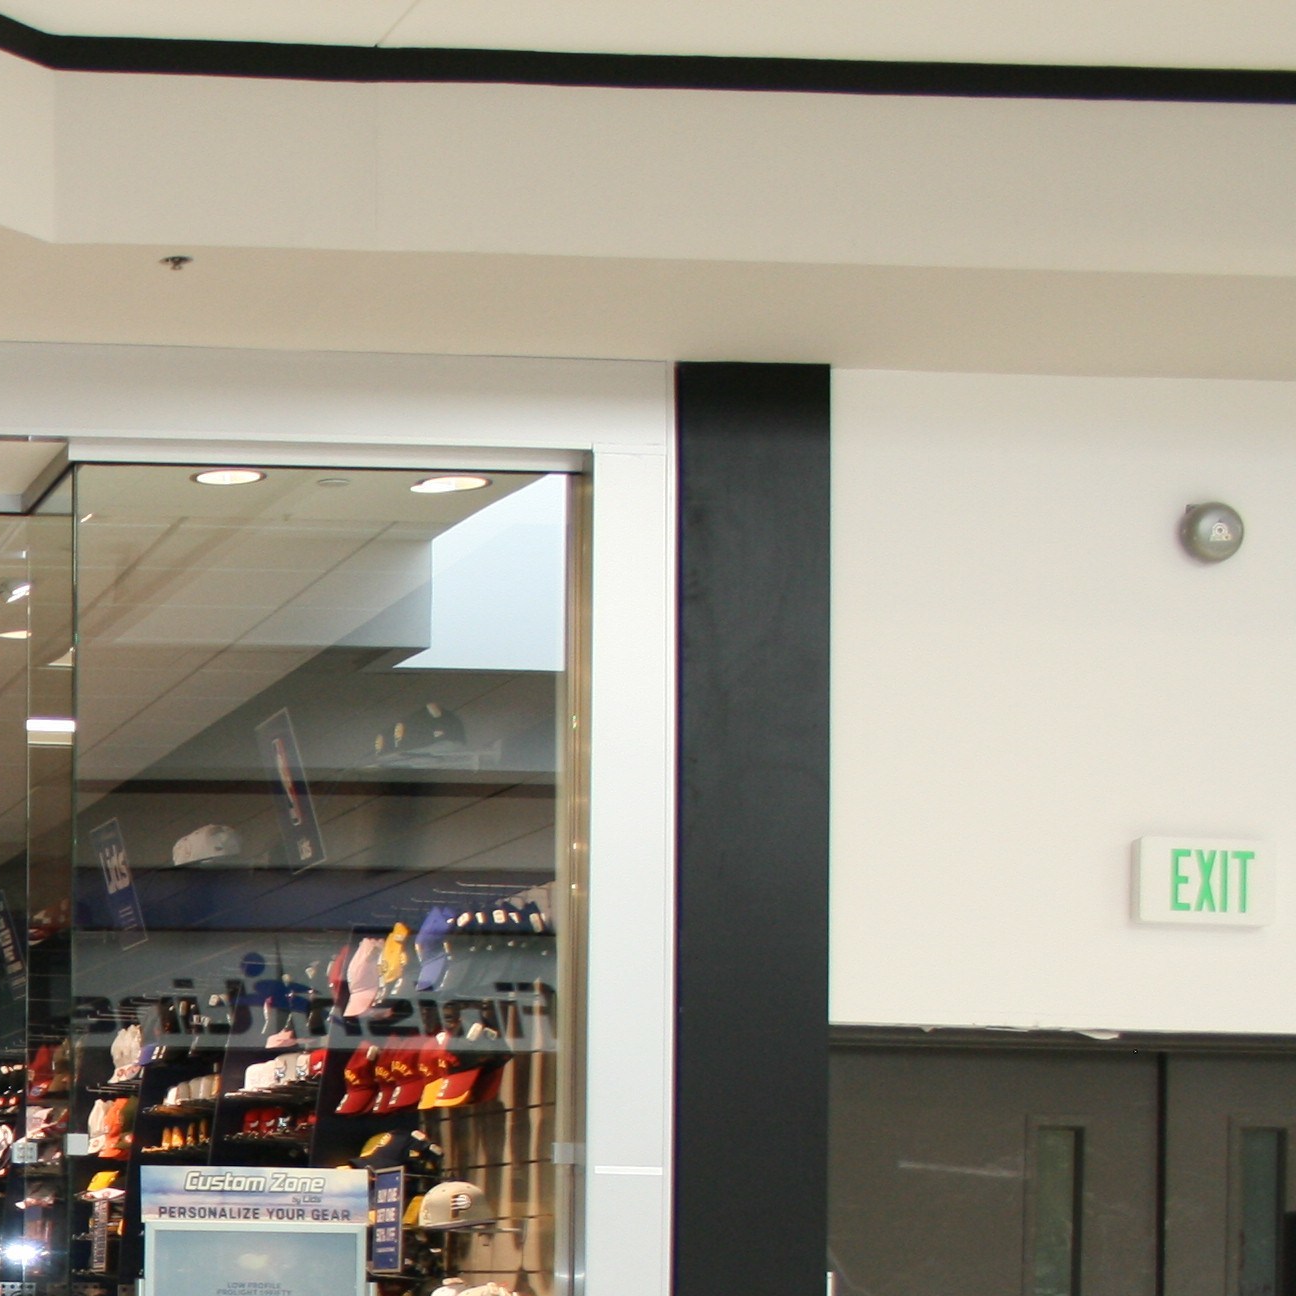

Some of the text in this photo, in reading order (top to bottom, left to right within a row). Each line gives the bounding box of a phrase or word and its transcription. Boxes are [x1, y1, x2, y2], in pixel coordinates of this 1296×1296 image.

[1171, 849, 1255, 913] EXIT
[184, 1170, 326, 1194] Custom Zone
[158, 1206, 351, 1221] PERSONALIZE YOUR GEAR
